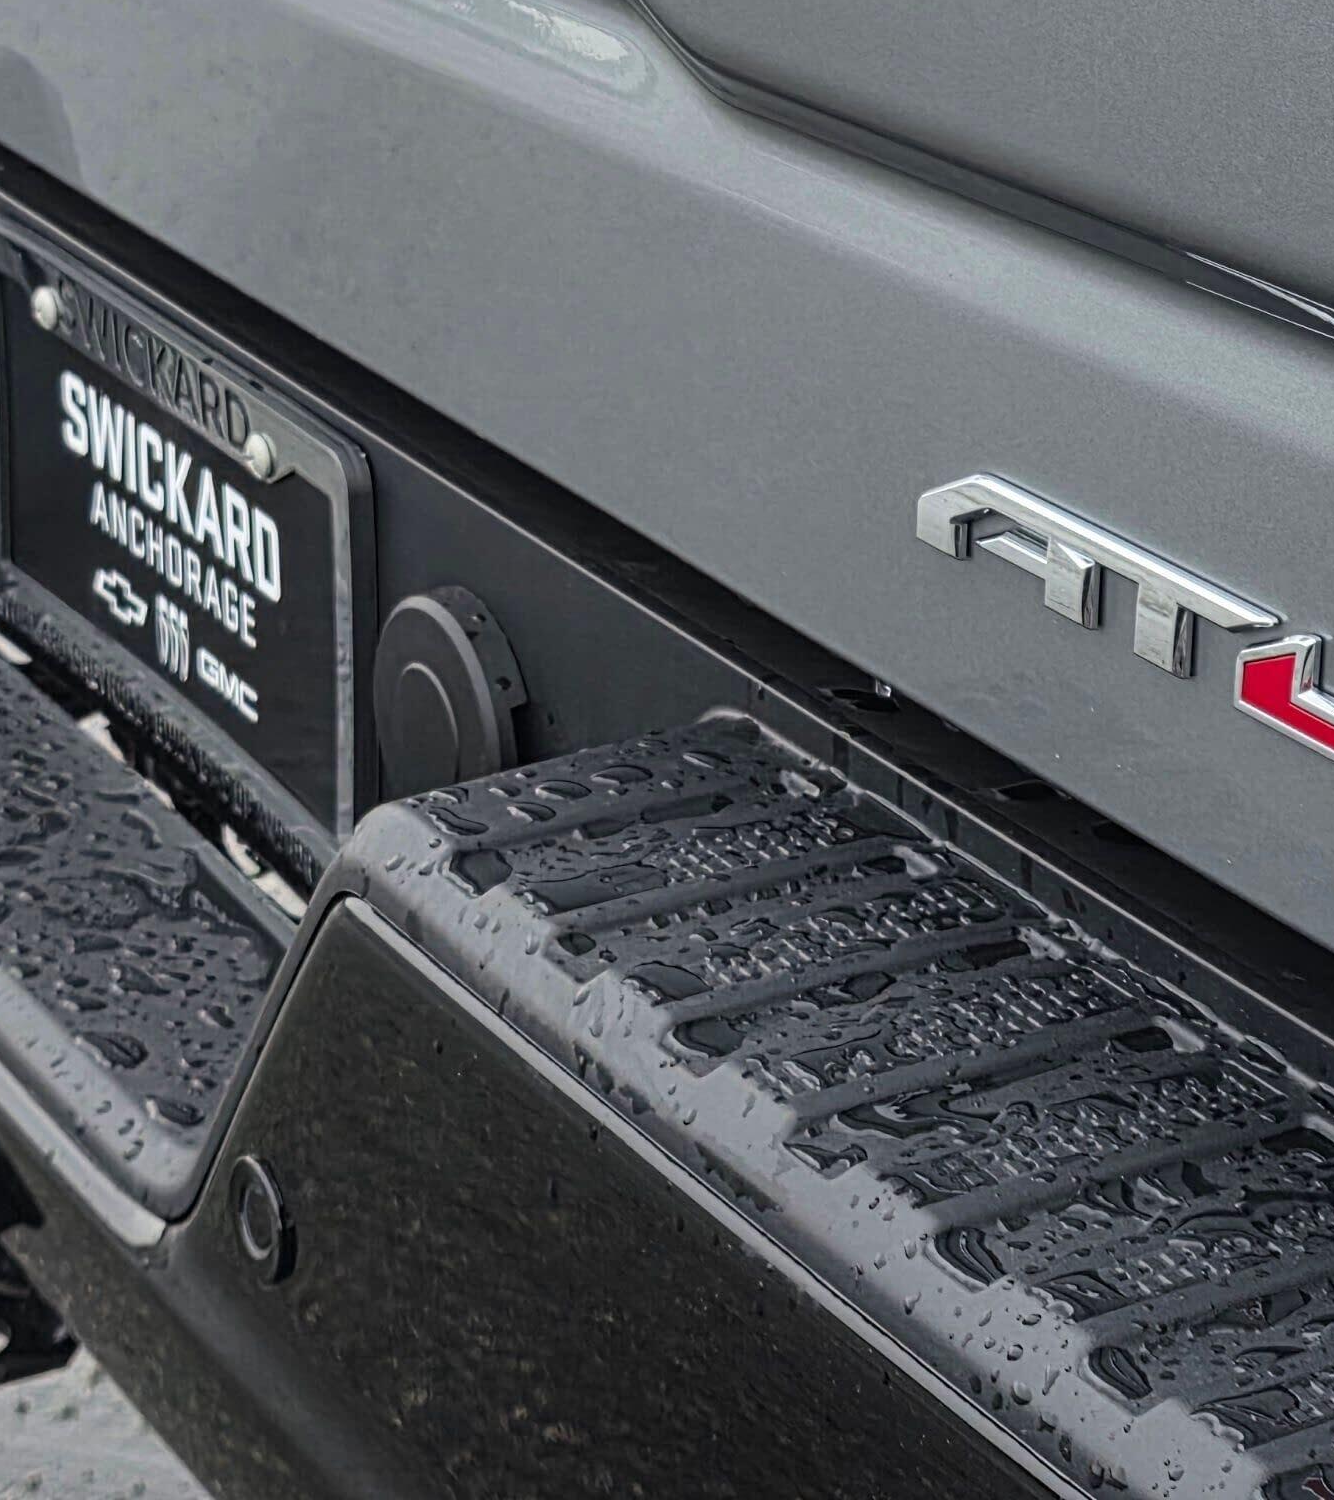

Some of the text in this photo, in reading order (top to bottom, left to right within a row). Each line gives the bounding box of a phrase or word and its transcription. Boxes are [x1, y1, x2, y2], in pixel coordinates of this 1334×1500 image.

[55, 275, 251, 450] SWICKARD
[60, 369, 281, 603] SWICKARD
[89, 481, 257, 649] ANCHORAGE
[196, 647, 259, 723] GMC
